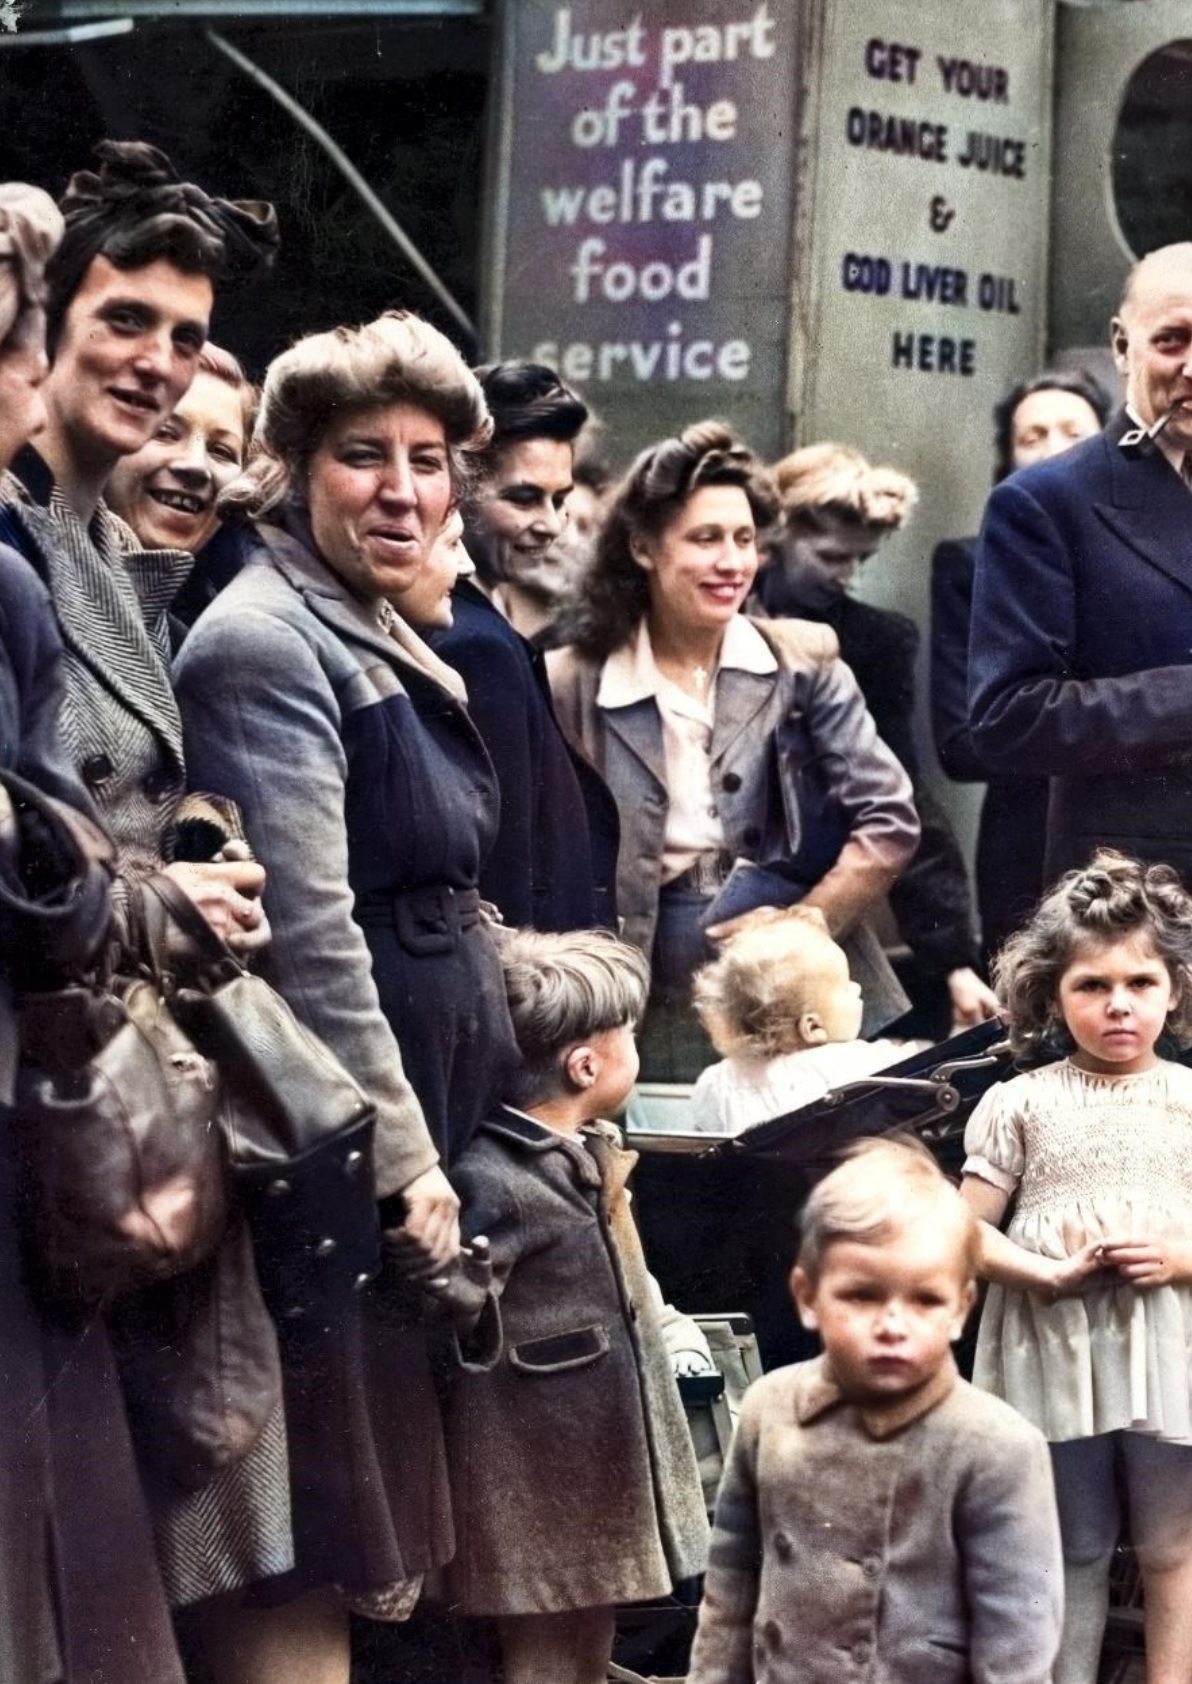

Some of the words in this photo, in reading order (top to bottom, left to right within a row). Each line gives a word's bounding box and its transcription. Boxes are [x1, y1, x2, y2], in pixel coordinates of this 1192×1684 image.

[535, 8, 646, 73] Just
[661, 3, 776, 89] part
[865, 38, 921, 85] GET
[936, 55, 1010, 104] YOUR
[572, 80, 636, 147] of
[642, 82, 738, 143] the
[846, 106, 947, 164] ORANGE
[958, 131, 1027, 180] JUICE
[541, 157, 764, 227] welfare
[929, 195, 955, 233] &
[571, 234, 713, 304] food
[842, 252, 892, 296] COD
[902, 262, 968, 308] LIVER
[977, 272, 1021, 316] OIL
[534, 321, 751, 381] service
[891, 331, 976, 377] HERE
